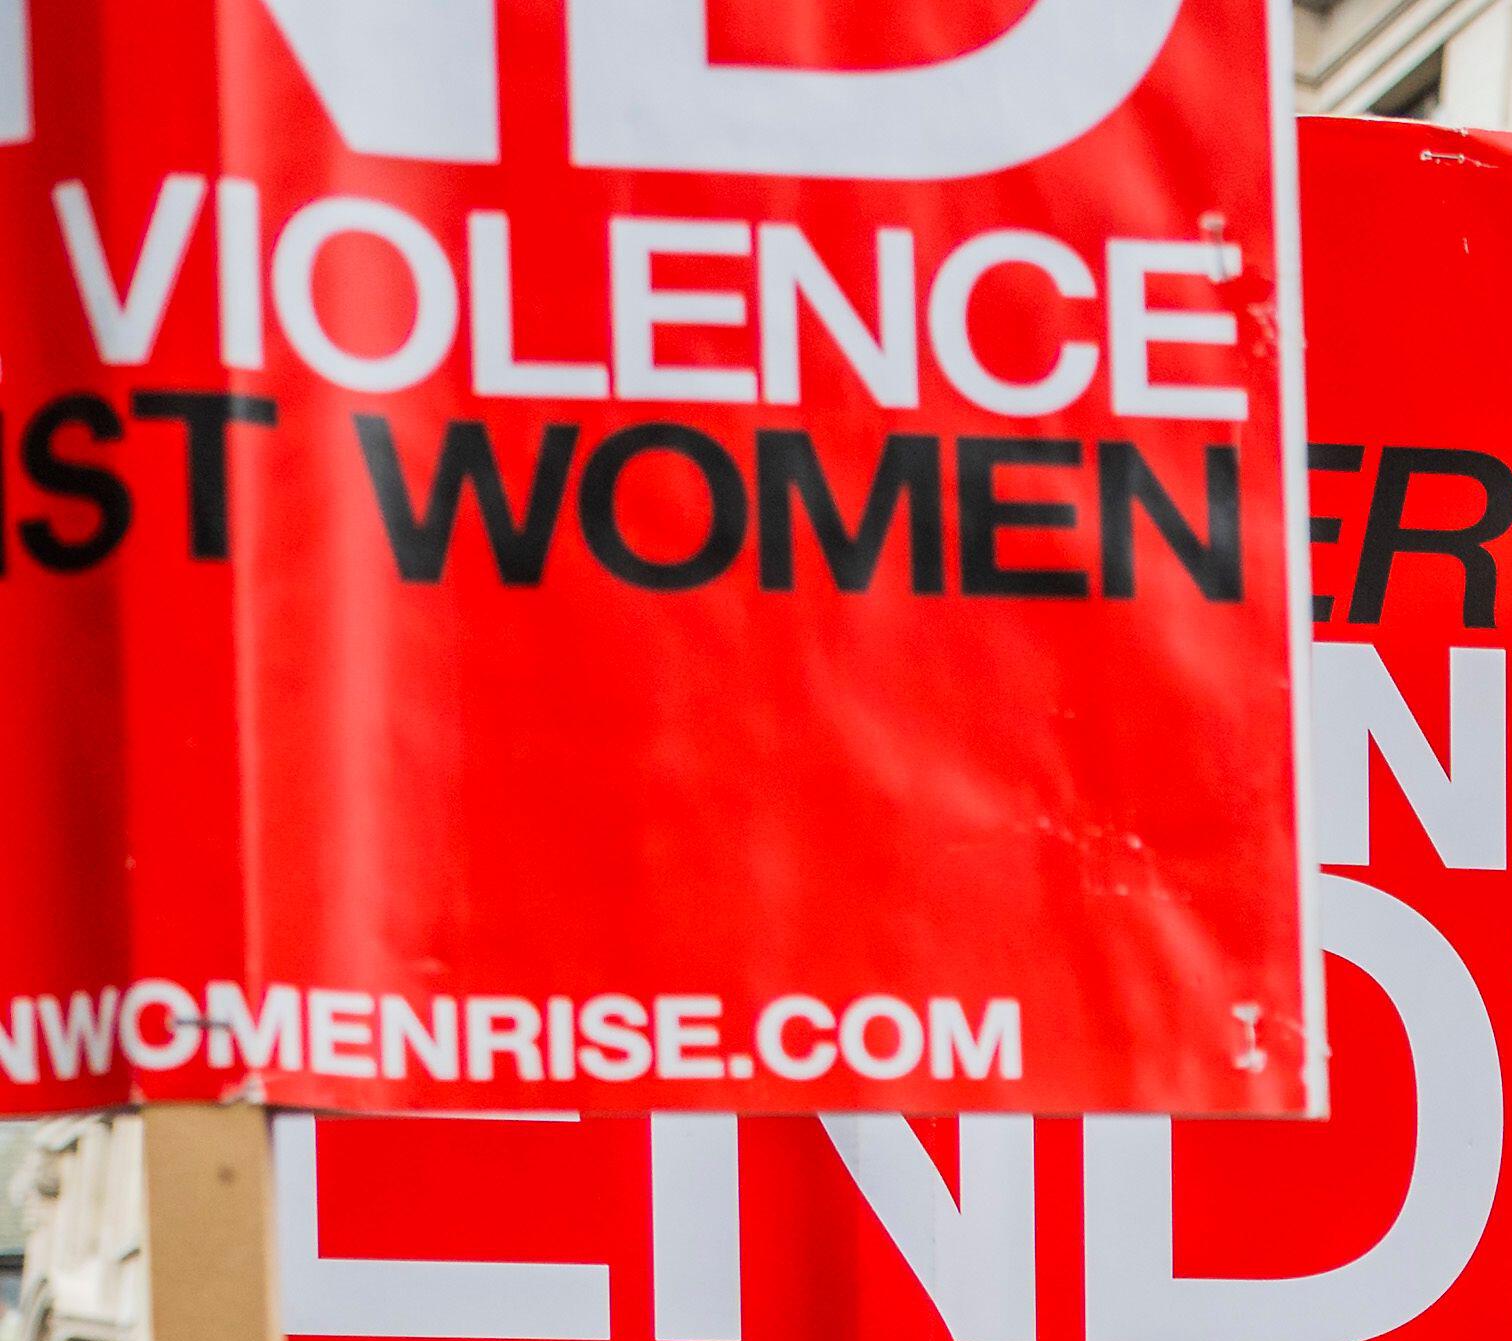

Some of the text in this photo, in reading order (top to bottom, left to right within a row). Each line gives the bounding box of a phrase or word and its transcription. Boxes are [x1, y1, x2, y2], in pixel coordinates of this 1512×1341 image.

[55, 175, 1250, 422] VIOLENCE
[0, 388, 1246, 602] ST WOMEN
